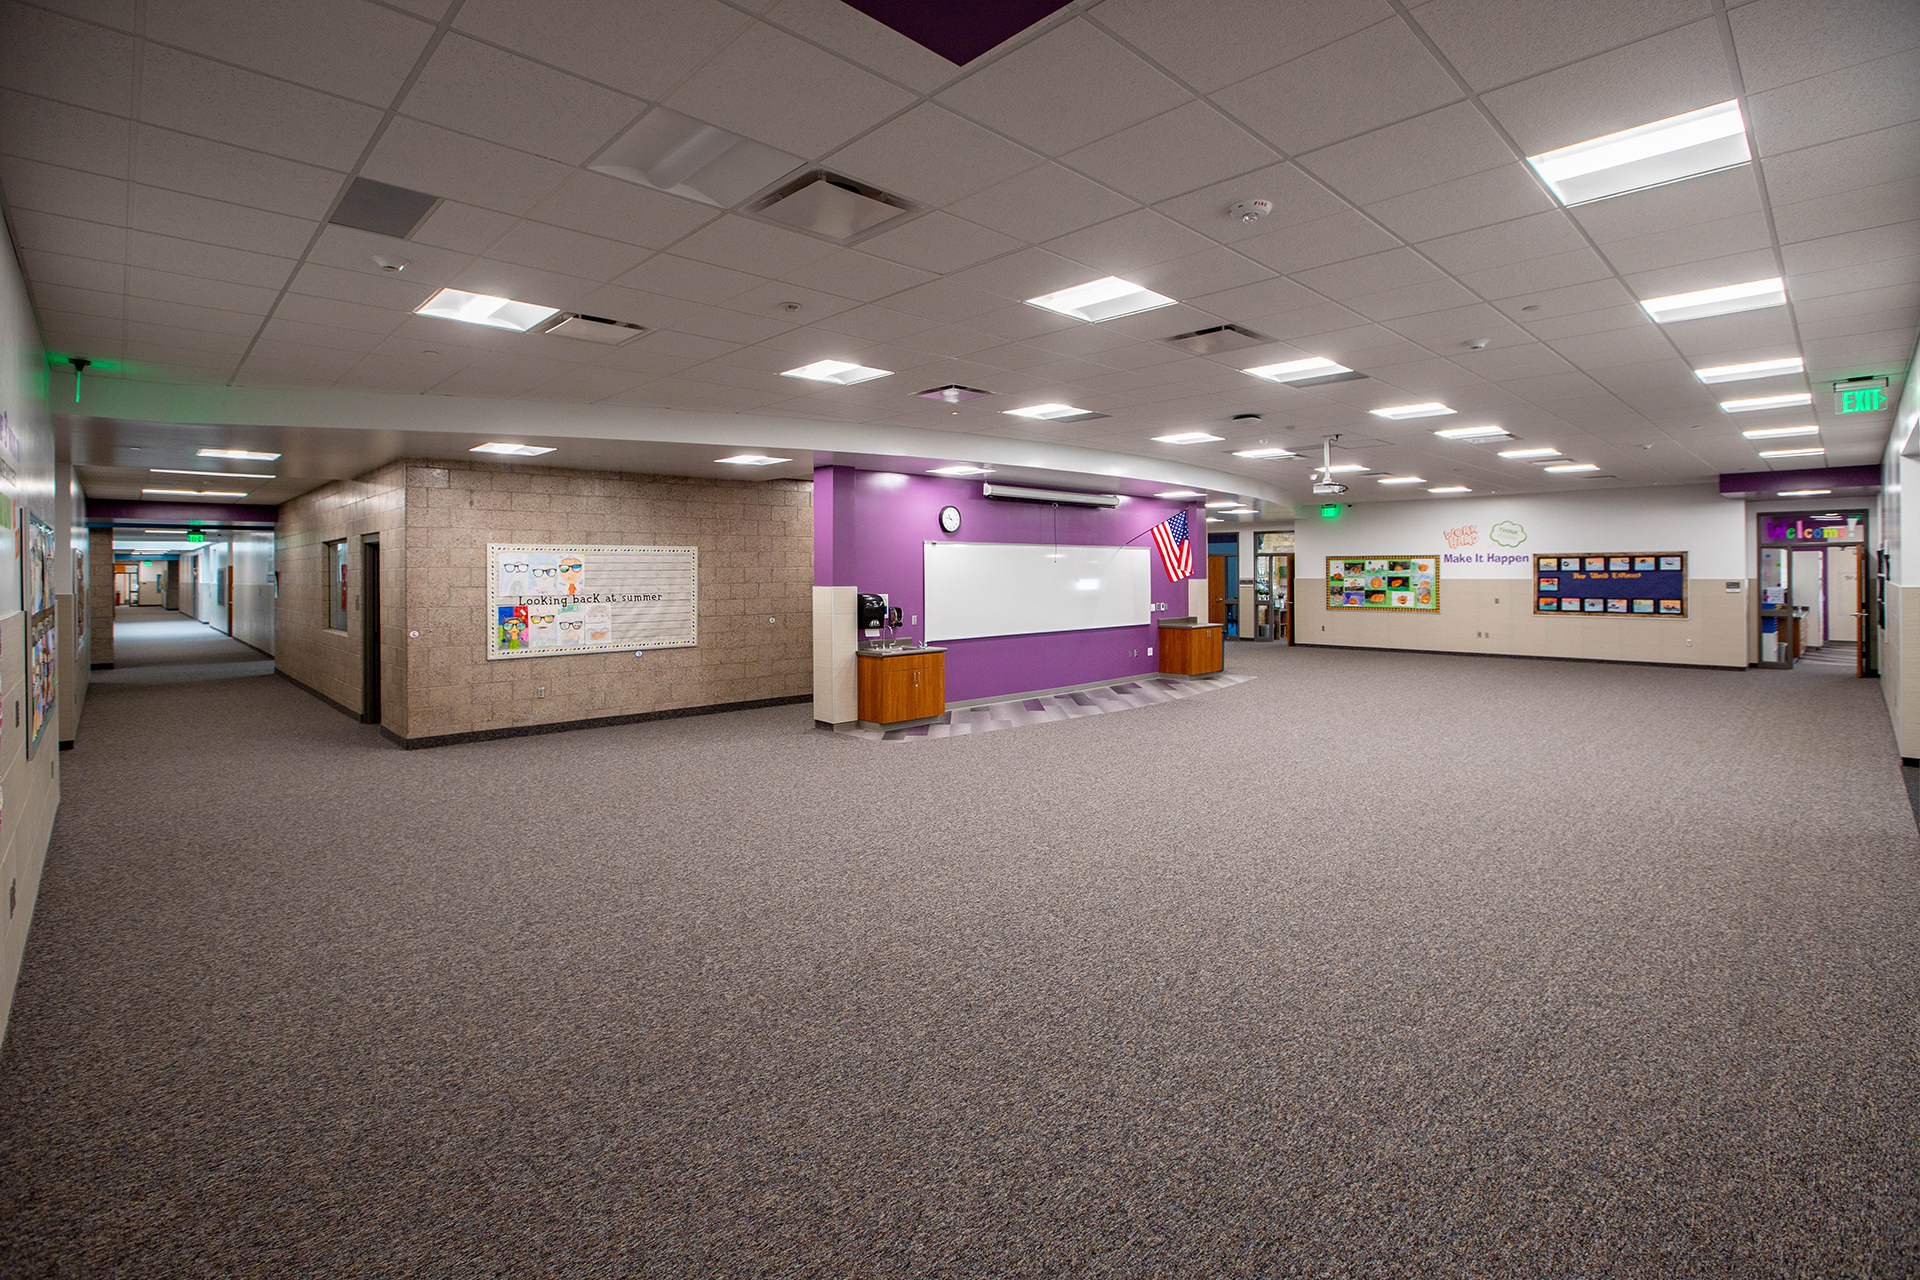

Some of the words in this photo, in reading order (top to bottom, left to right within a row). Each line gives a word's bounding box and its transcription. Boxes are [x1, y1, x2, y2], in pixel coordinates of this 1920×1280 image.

[1842, 388, 1882, 413] EXIT
[1443, 525, 1479, 541] WORK
[1499, 527, 1519, 536] THINK
[1767, 518, 1857, 539] Welcome!
[1448, 535, 1479, 549] HARD
[1443, 553, 1473, 563] Make
[1475, 553, 1484, 563] It
[1487, 552, 1529, 565] Happen
[605, 593, 617, 602] at
[621, 594, 663, 602] summer
